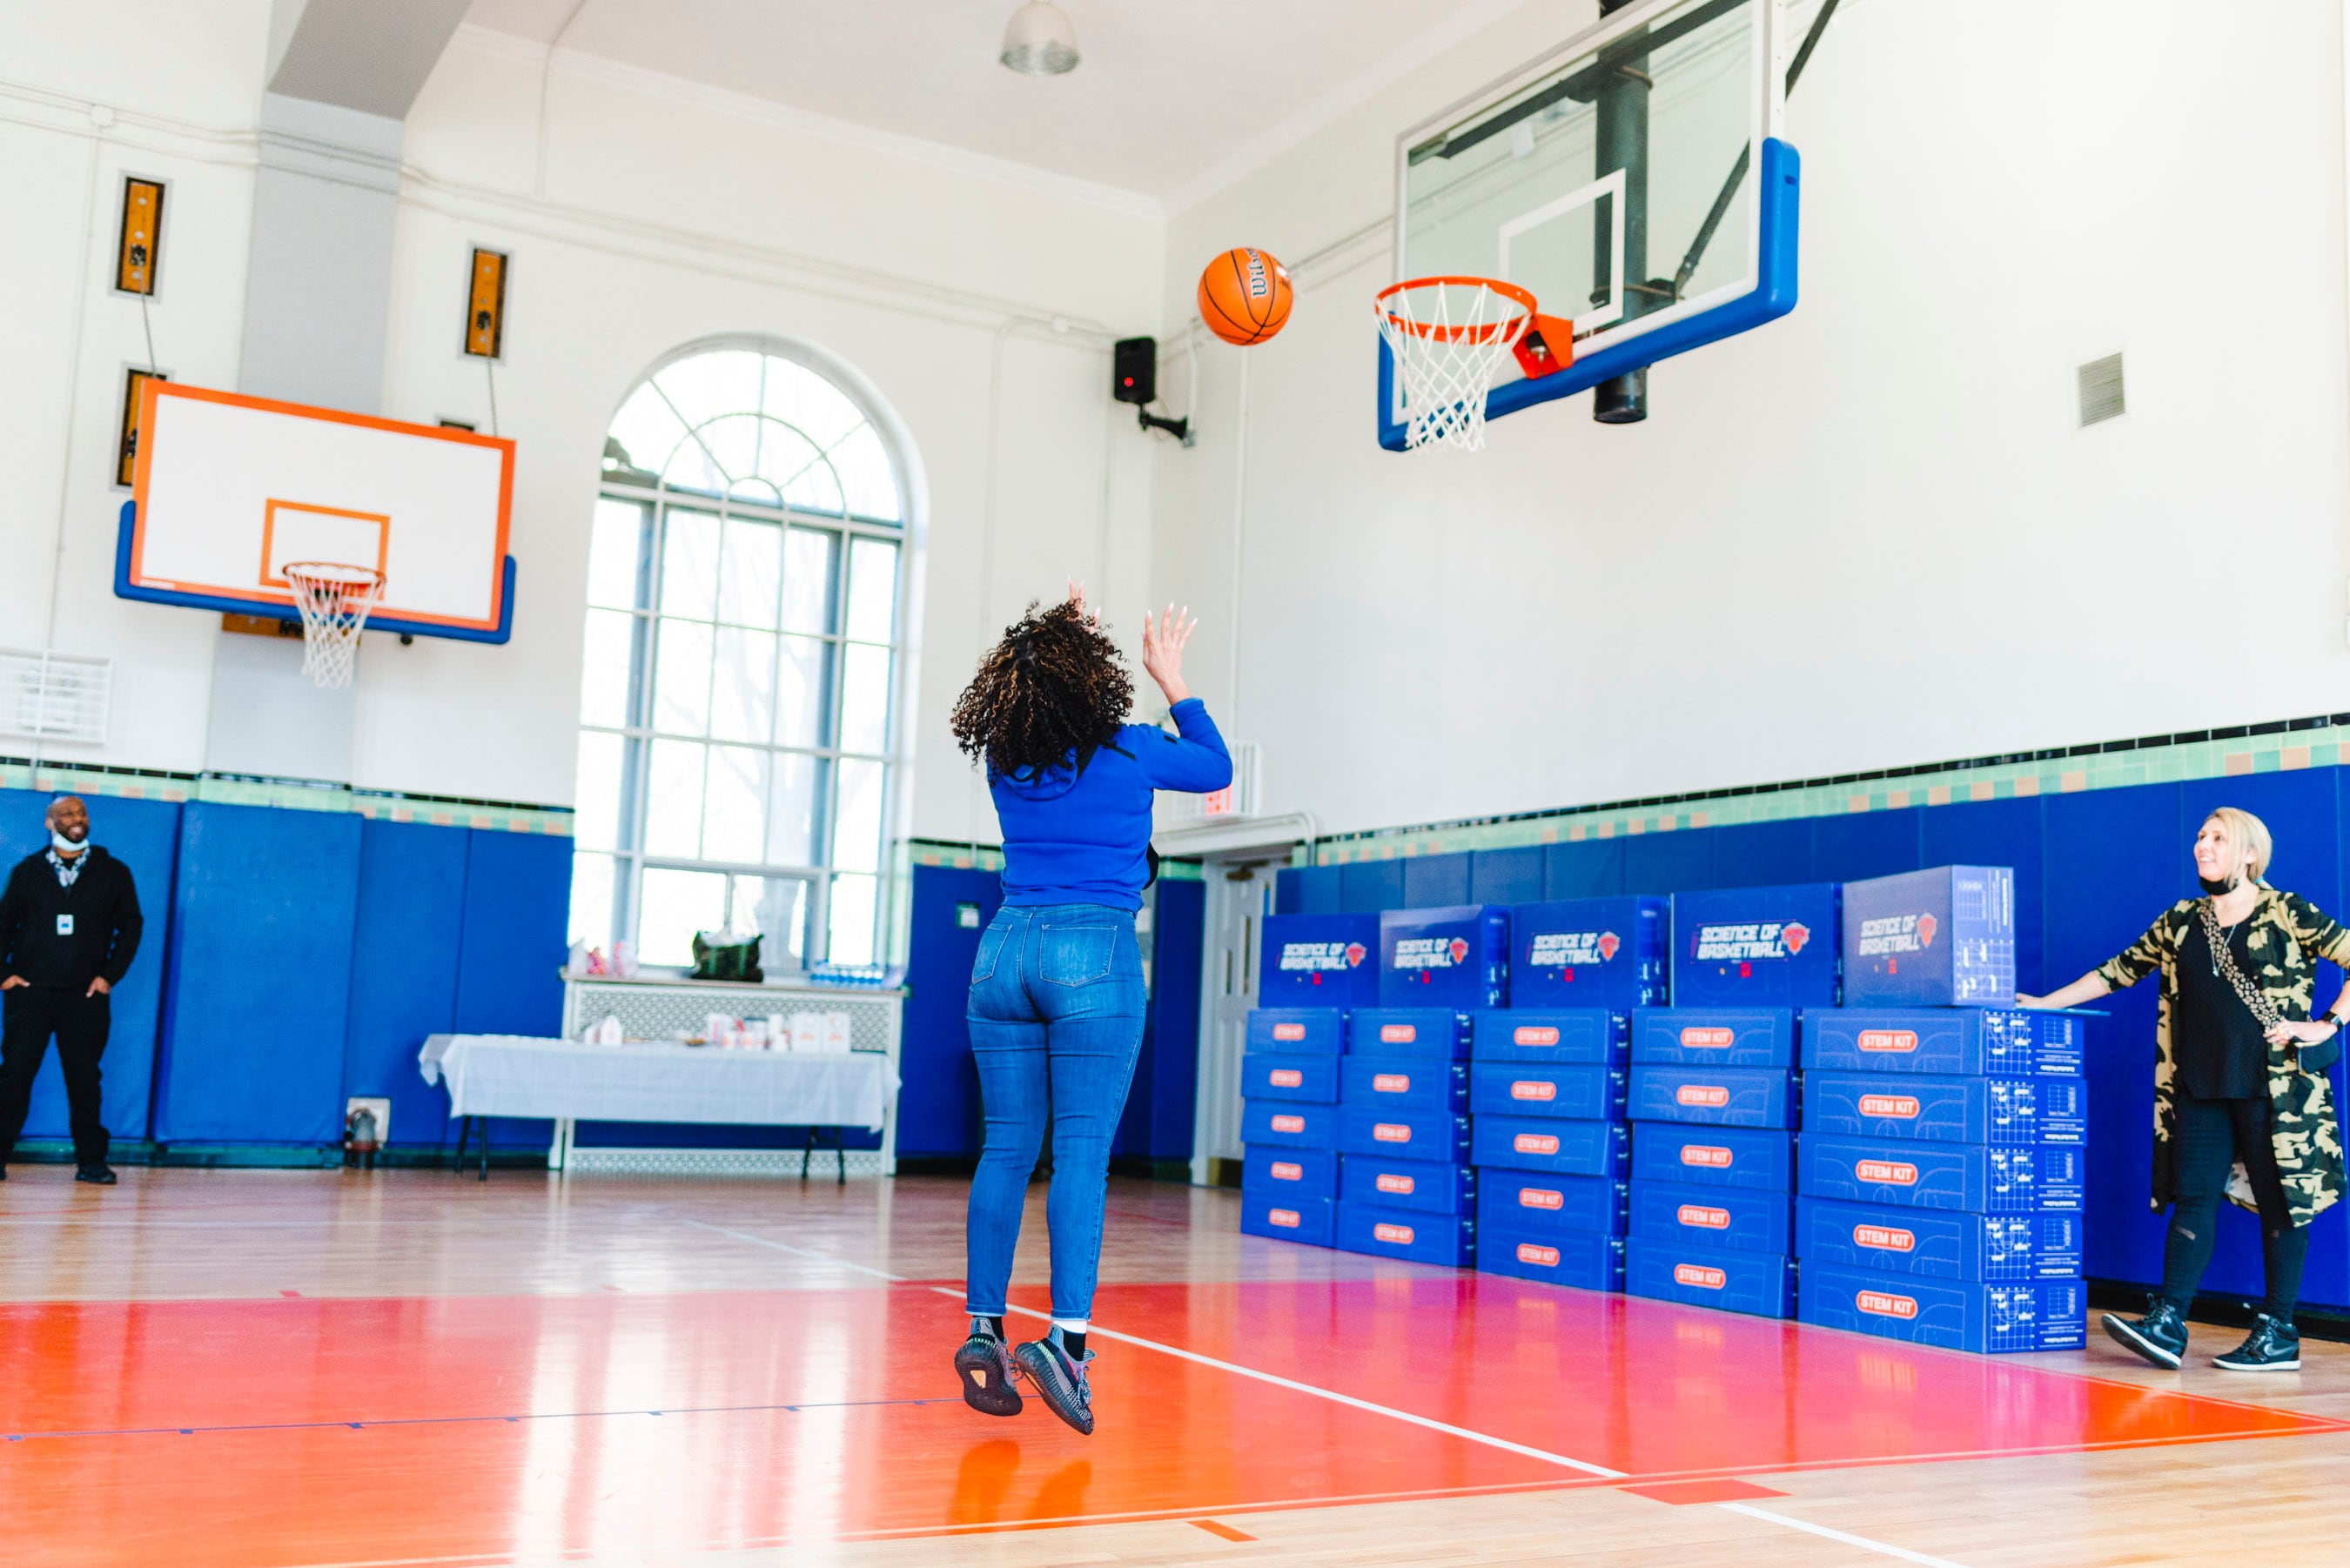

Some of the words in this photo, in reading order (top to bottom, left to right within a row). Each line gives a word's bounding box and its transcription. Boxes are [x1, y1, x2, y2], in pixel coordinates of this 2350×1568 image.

[1700, 924, 1760, 943] SCIENCE
[1760, 923, 1781, 941] OF
[1860, 916, 1902, 939] SCIENCE
[1902, 915, 1917, 933] OF
[1533, 933, 1581, 949] SCIENCE
[1580, 932, 1598, 948] OF
[1857, 933, 1920, 956] BASKETBALL
[1530, 948, 1601, 966] BASKETBALL
[1696, 941, 1785, 960] BASKETBALL
[1518, 1030, 1541, 1042] STEM
[1541, 1030, 1555, 1042] KIT
[1685, 1031, 1712, 1043] STEM
[1712, 1031, 1729, 1043] KIT
[1862, 1034, 1893, 1049] STEM
[1893, 1034, 1912, 1049] KIT
[1514, 1084, 1537, 1097] STEM
[1538, 1084, 1552, 1097] KIT
[1681, 1089, 1708, 1102] STEM
[1708, 1089, 1724, 1102] KIT
[1863, 1097, 1894, 1115] STEM
[1895, 1098, 1914, 1115] KIT
[1518, 1138, 1541, 1150] STEM
[1541, 1138, 1555, 1150] KIT
[1685, 1149, 1711, 1163] STEM
[1711, 1149, 1728, 1164] KIT
[1860, 1162, 1892, 1181] STEM
[1893, 1166, 1912, 1183] KIT
[1522, 1190, 1545, 1205] STEM
[1545, 1194, 1559, 1207] KIT
[1682, 1207, 1709, 1224] STEM
[1709, 1211, 1725, 1227] KIT
[1857, 1227, 1889, 1246] STEM
[1890, 1231, 1909, 1250] KIT
[1521, 1245, 1542, 1262] STEM
[1542, 1250, 1555, 1264] KIT
[1678, 1265, 1704, 1283] STEM
[1704, 1270, 1721, 1287] KIT
[1860, 1292, 1892, 1313] STEM
[1893, 1298, 1912, 1317] KIT
